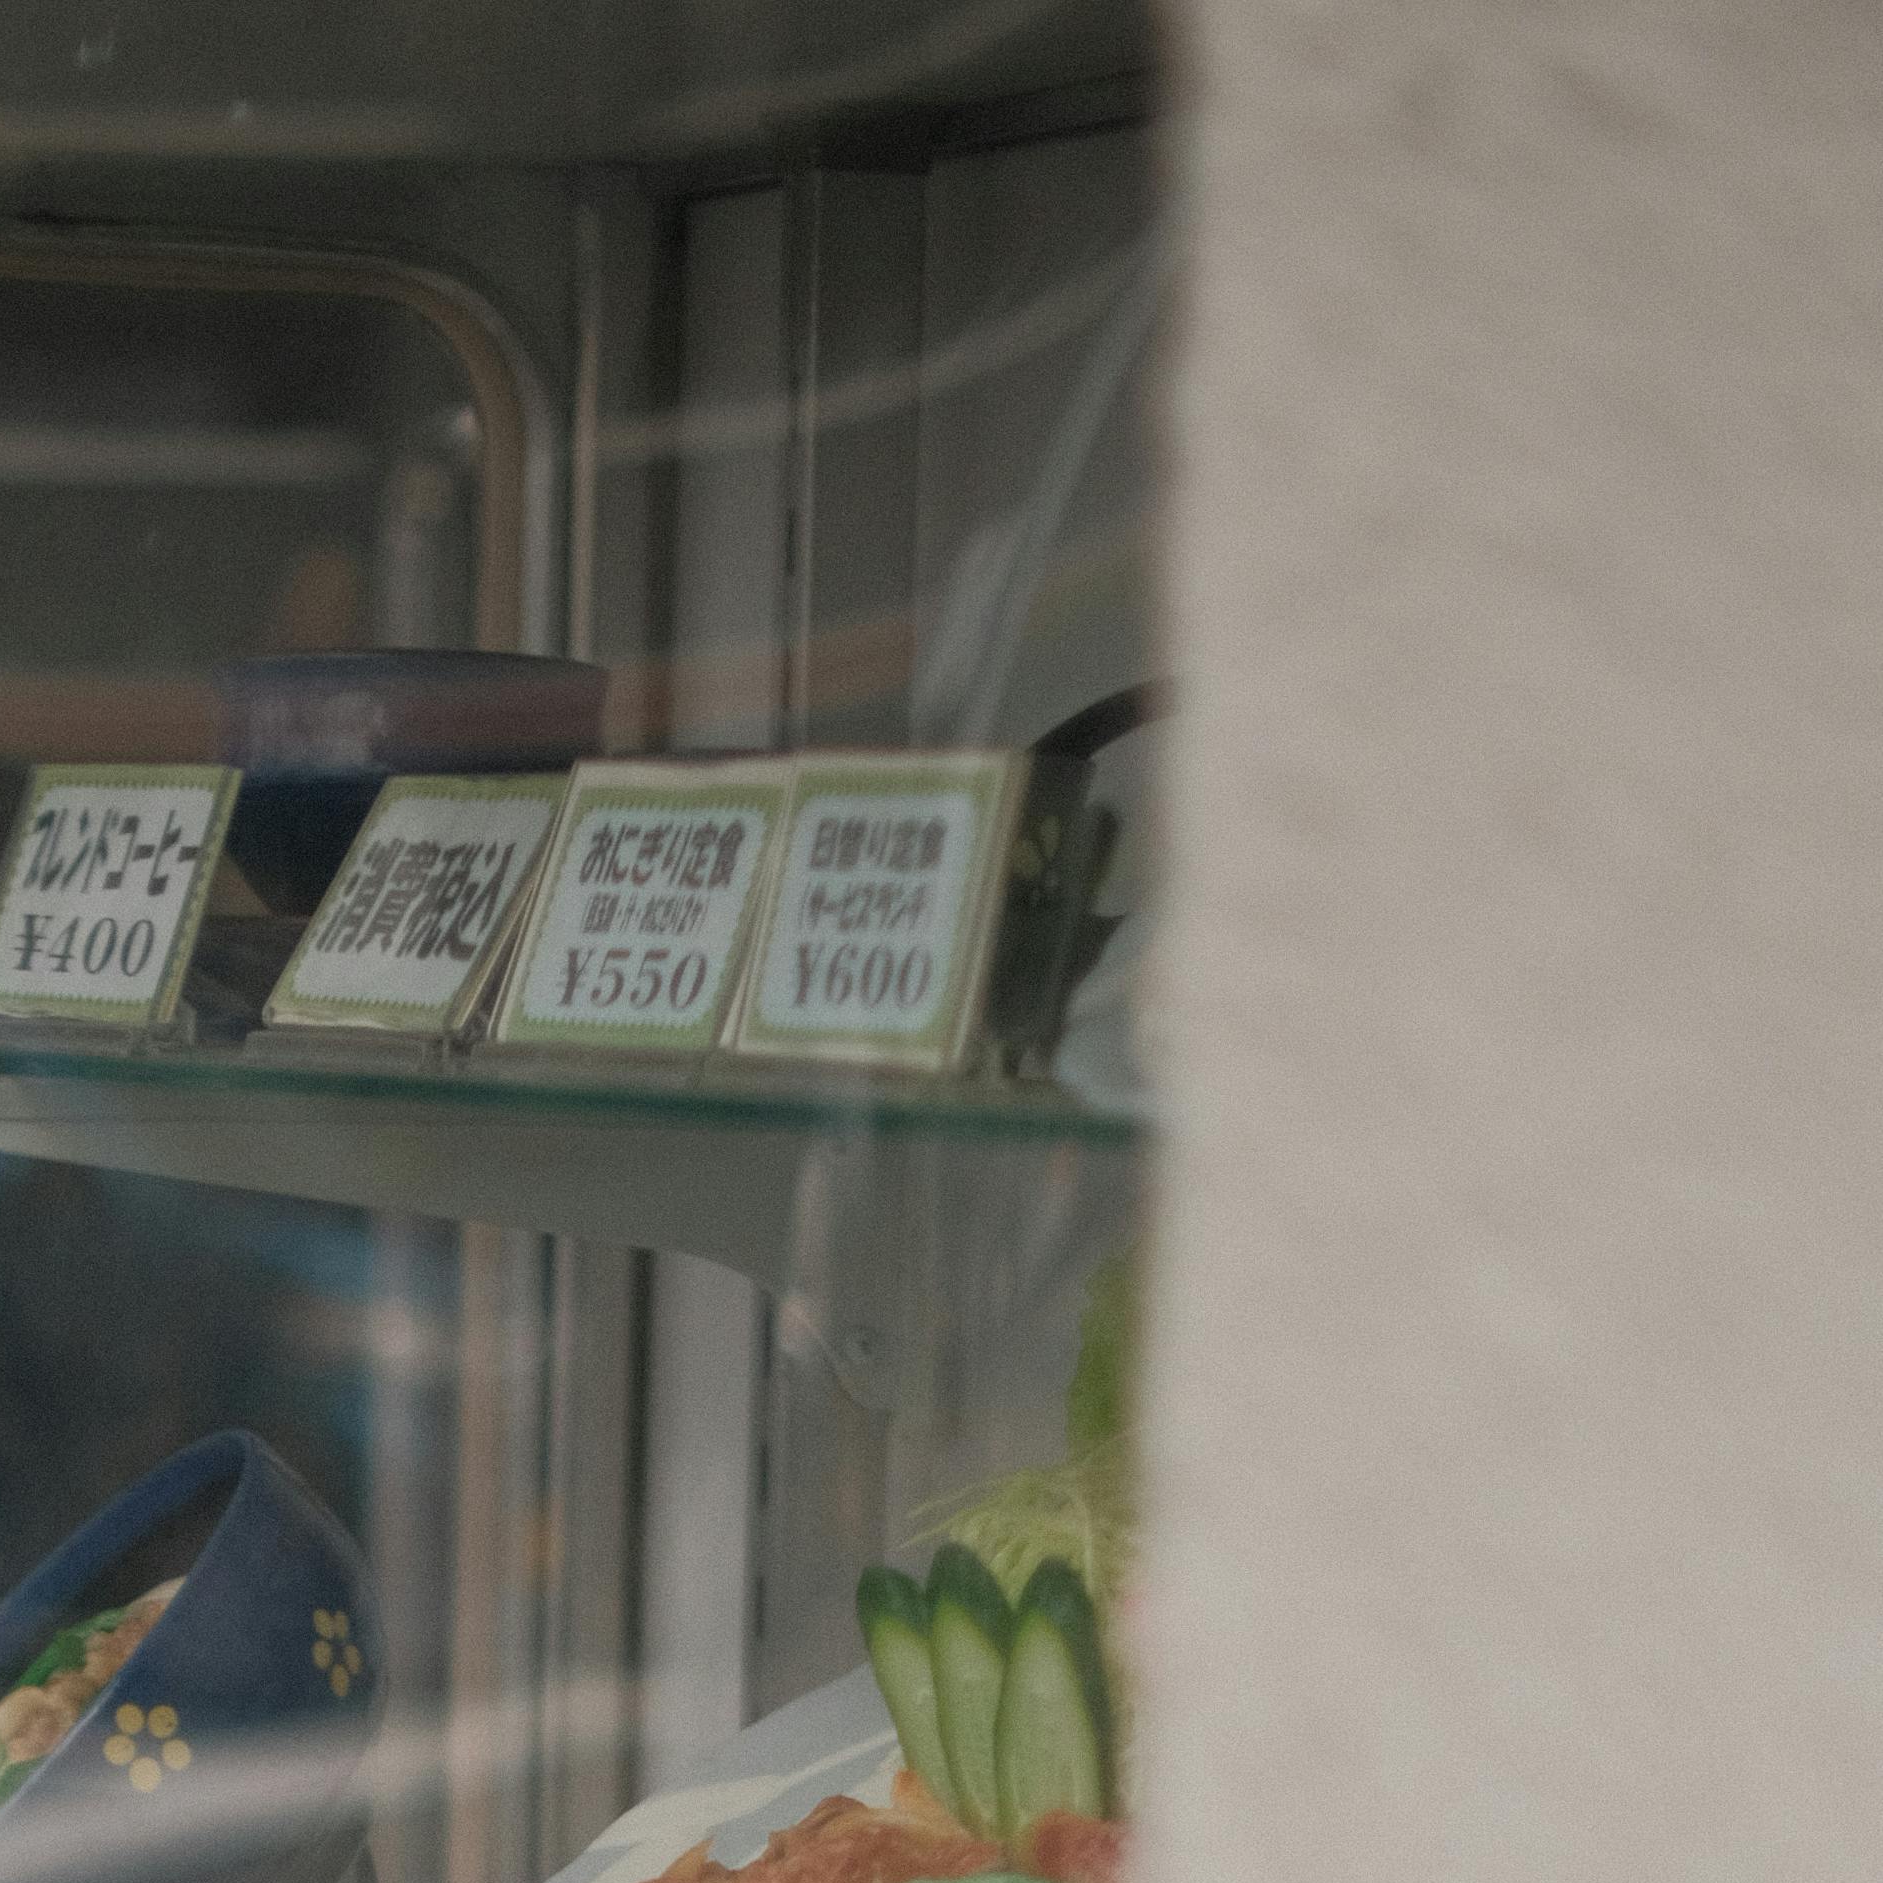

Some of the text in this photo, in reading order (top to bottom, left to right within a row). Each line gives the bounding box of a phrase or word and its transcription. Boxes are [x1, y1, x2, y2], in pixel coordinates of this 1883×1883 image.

[579, 820, 744, 891] おにぎり定食
[317, 839, 517, 961] 消費税込
[13, 913, 156, 977] ¥400
[555, 947, 708, 1010] ¥550
[791, 942, 934, 1010] ¥600
